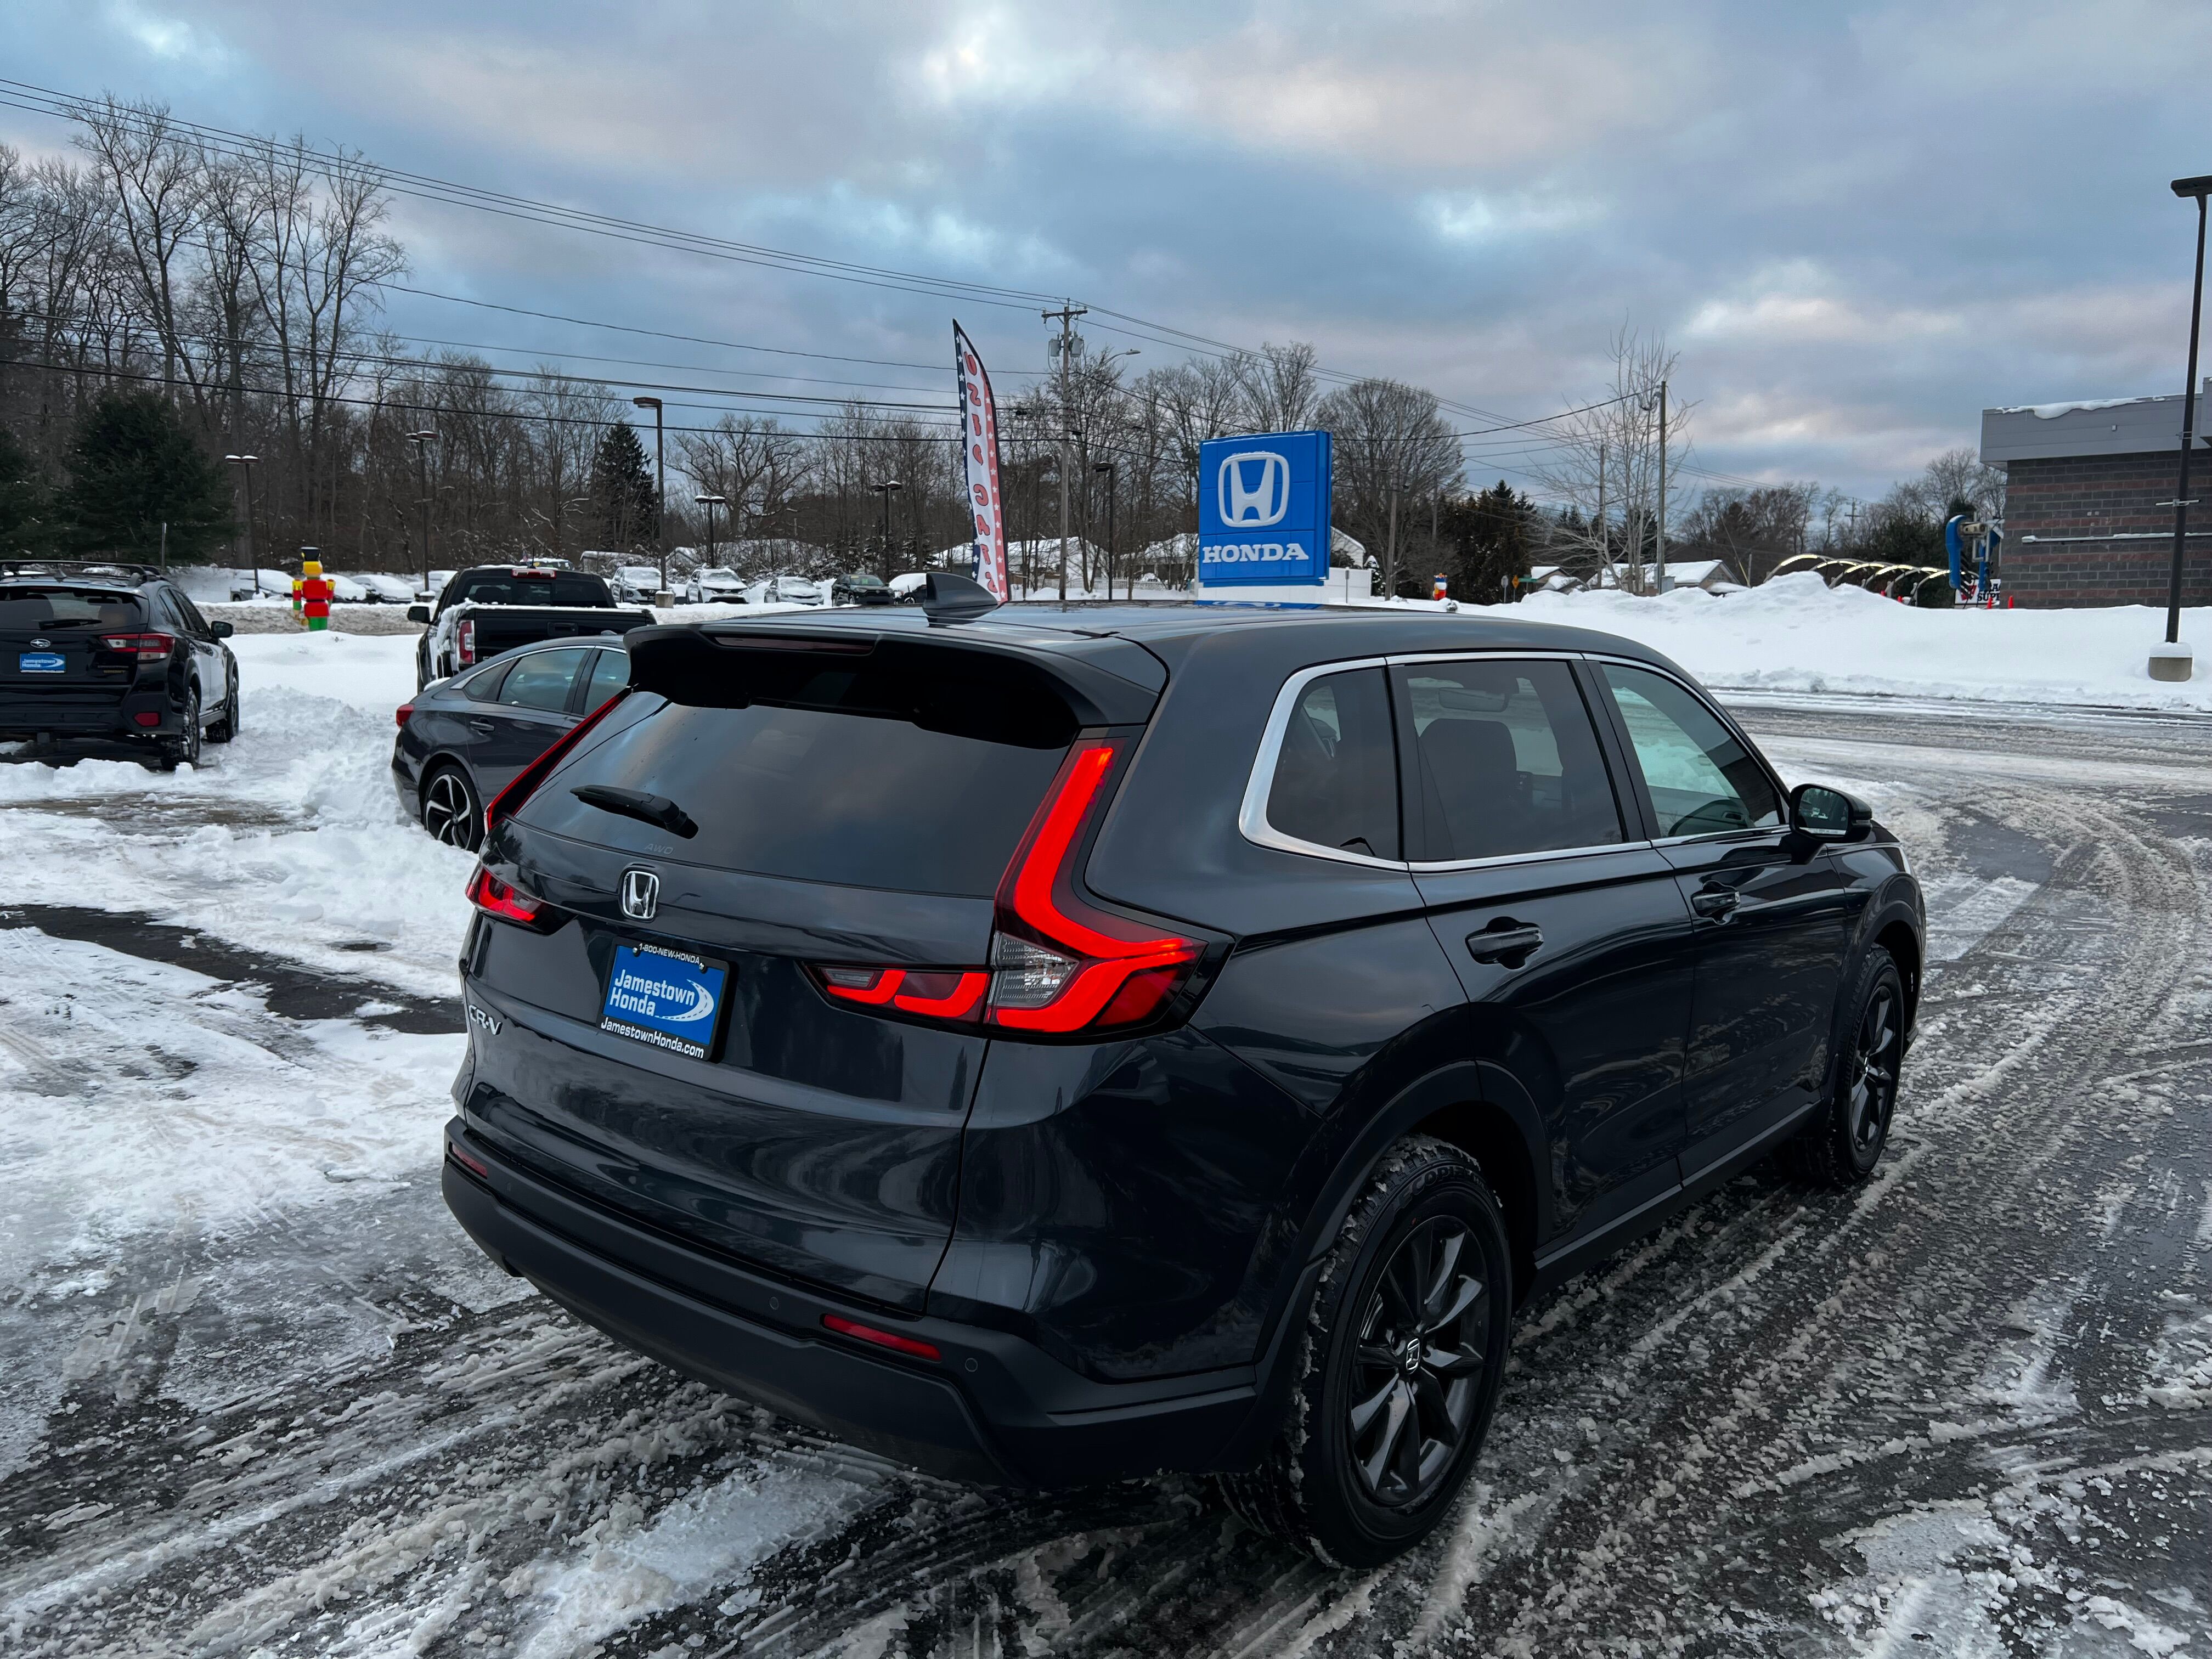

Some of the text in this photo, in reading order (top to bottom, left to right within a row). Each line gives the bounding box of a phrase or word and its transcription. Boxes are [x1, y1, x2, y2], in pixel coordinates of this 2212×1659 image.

[1202, 543, 1309, 563] HONDA
[644, 843, 674, 854] AWD
[639, 943, 700, 965] 1-800-NEW-HONDA
[610, 987, 656, 1017] Honda
[614, 969, 695, 1006] Jamestown
[469, 1005, 502, 1035] CR-V
[601, 1017, 704, 1059] JamestownHonda.com
